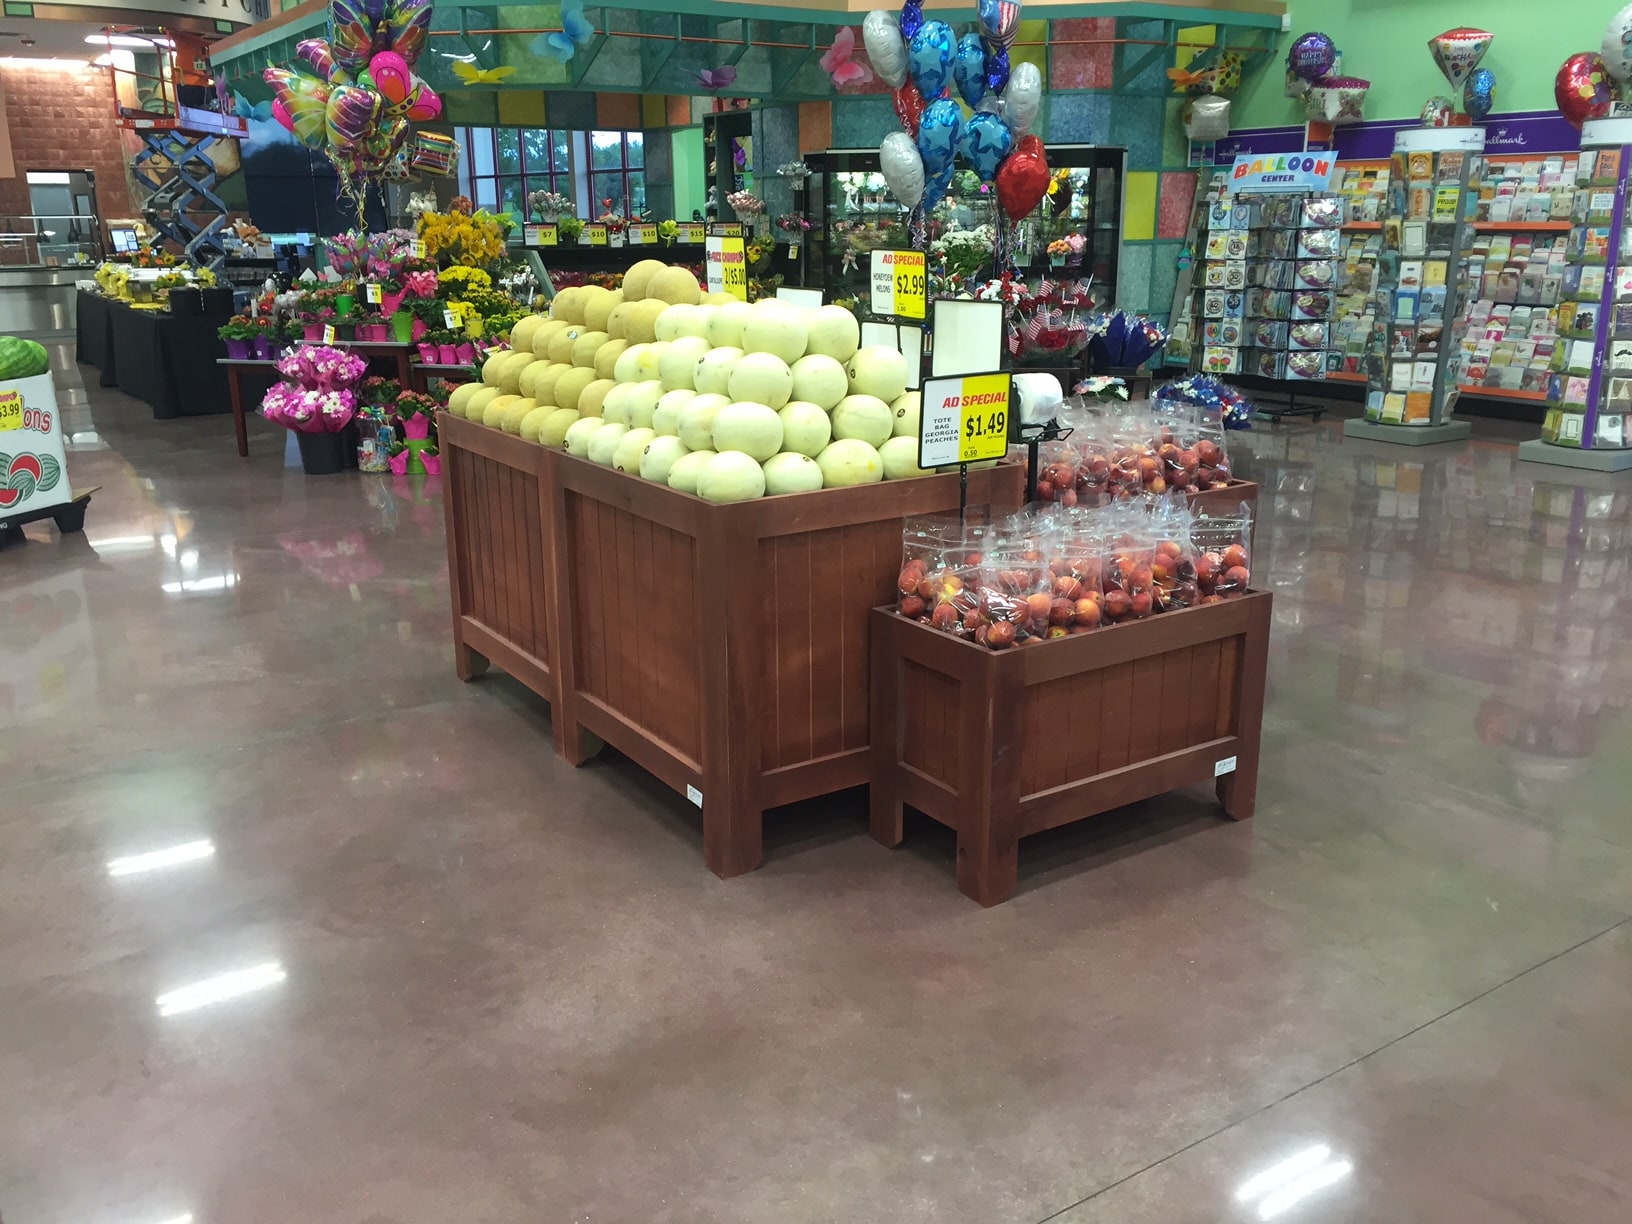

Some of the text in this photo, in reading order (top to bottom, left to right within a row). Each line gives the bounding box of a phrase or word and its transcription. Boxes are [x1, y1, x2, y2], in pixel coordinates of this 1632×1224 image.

[1485, 132, 1527, 145] allmark
[1233, 156, 1329, 179] BALLOON
[1261, 174, 1295, 183] CENTER
[882, 254, 925, 266] AD SPECIAL
[897, 273, 925, 298] $2.99
[942, 392, 1007, 409] AD SPECIAL
[965, 411, 1005, 442] $1.49
[925, 429, 959, 438] GEORGIA
[925, 436, 959, 444] PEACHES
[964, 449, 977, 457] 0.50
